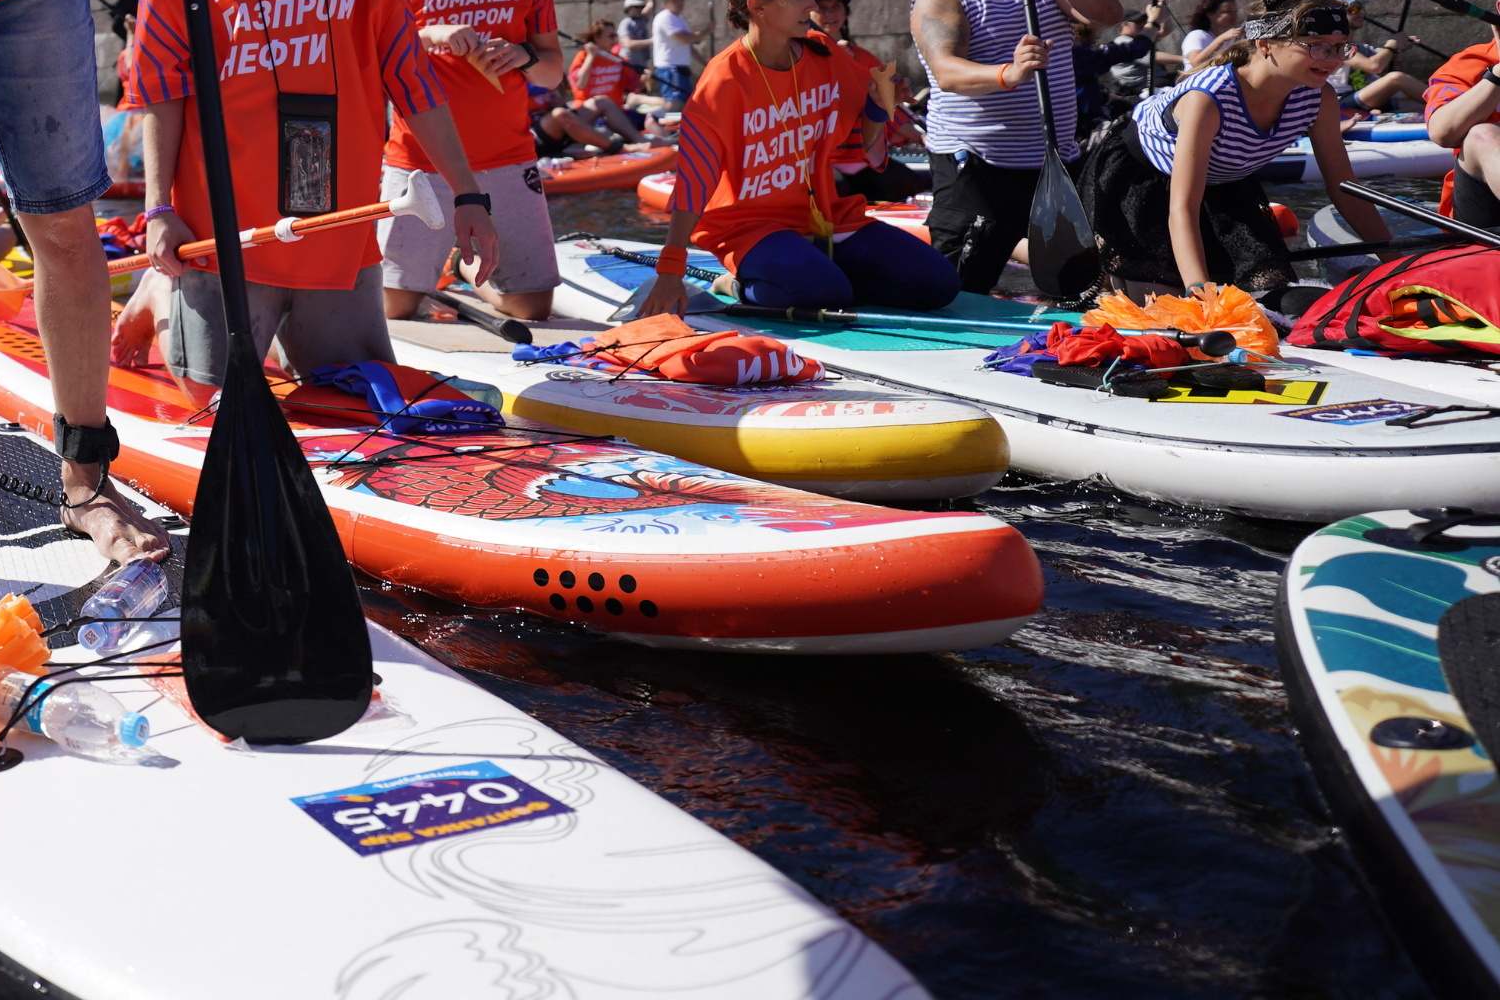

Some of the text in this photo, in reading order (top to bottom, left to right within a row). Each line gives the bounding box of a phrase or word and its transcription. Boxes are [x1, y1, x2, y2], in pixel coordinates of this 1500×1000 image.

[219, 33, 328, 82] НЕФТИ
[742, 80, 840, 137] КОМАНДА
[742, 110, 839, 169] ГАЗПРОМ
[333, 781, 521, 835] 0445
